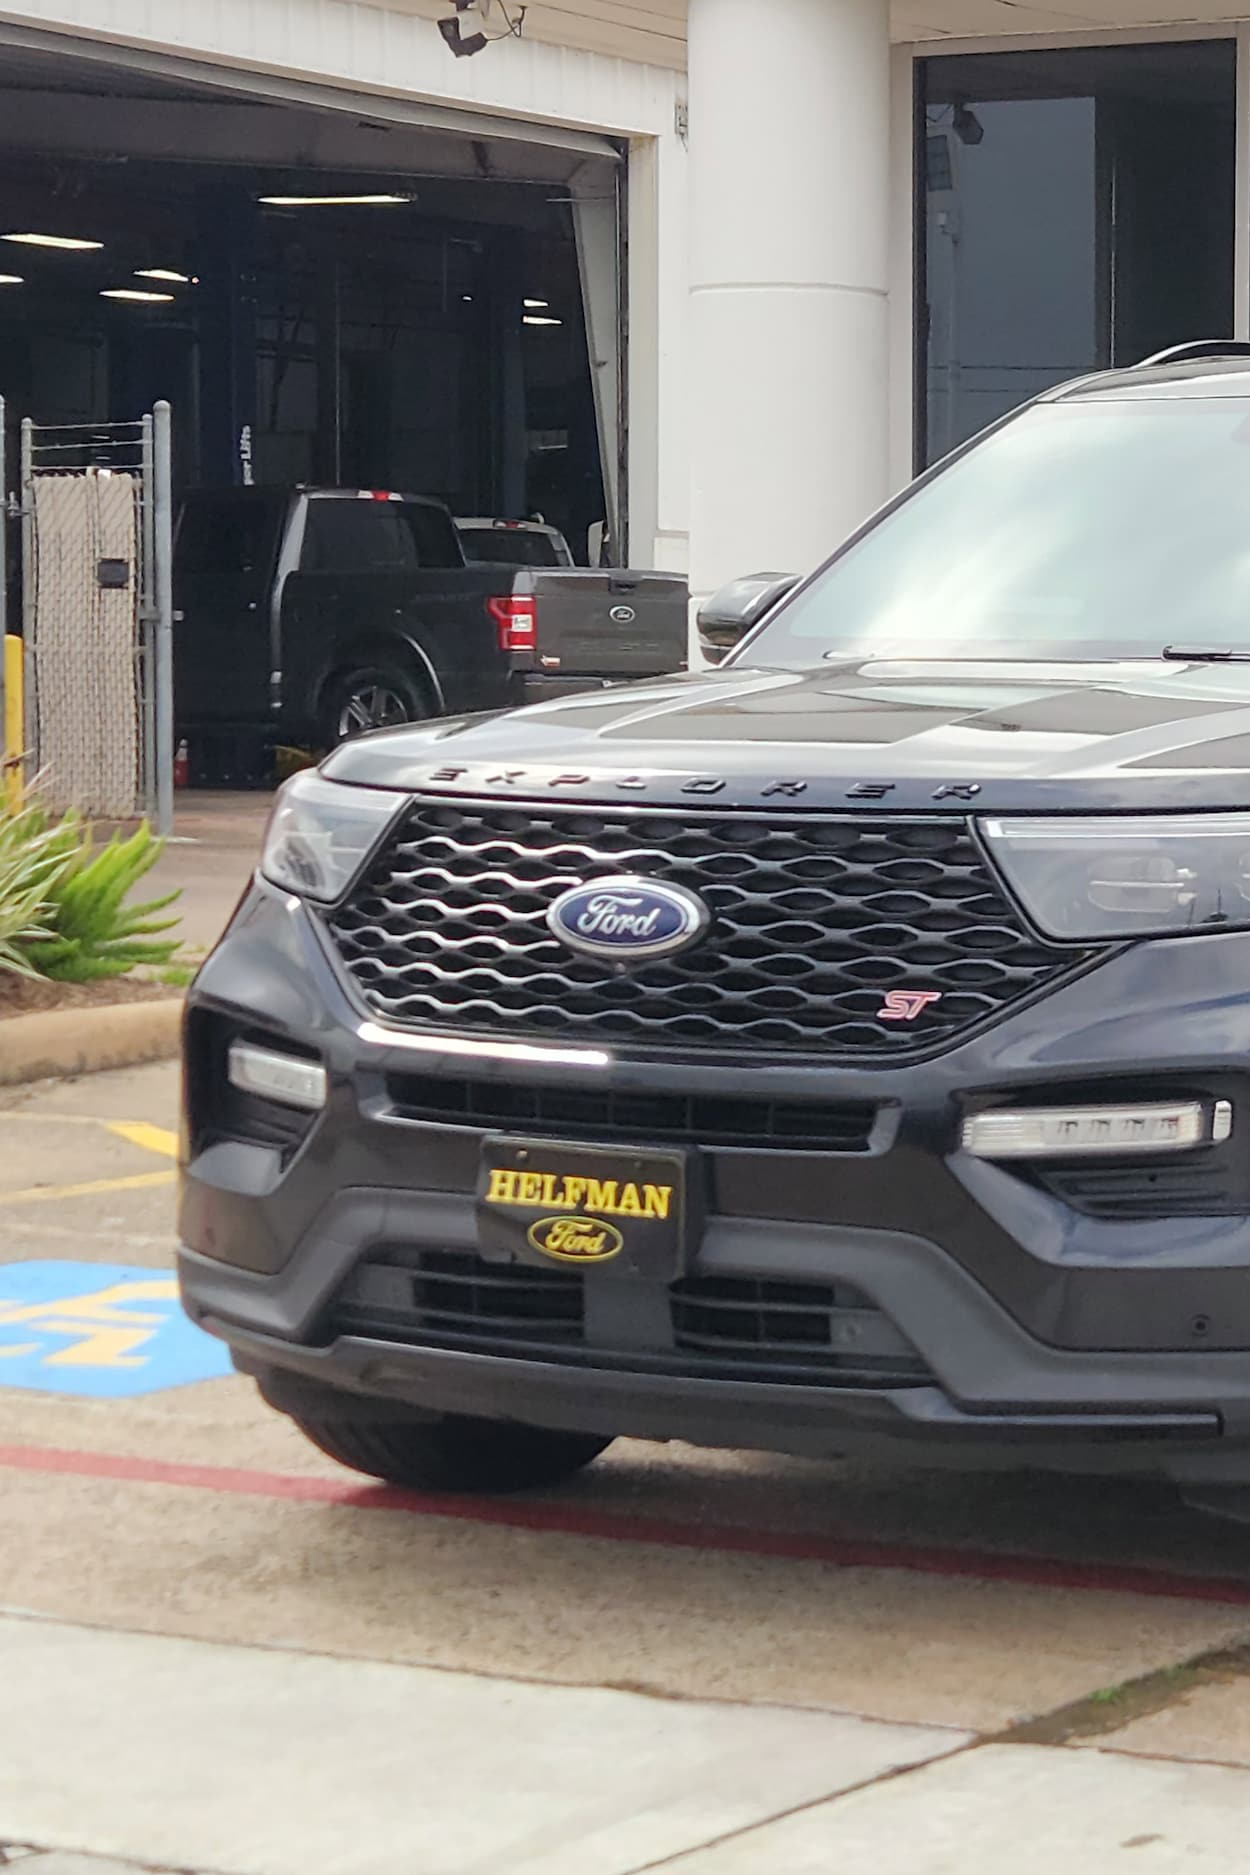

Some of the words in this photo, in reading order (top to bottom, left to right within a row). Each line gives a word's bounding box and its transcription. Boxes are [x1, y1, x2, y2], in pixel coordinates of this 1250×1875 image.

[429, 767, 981, 800] EXPLORER
[576, 894, 661, 936] Ford
[876, 989, 942, 1020] ST
[484, 1169, 672, 1219] HELFMAN
[544, 1219, 606, 1254] Ford
